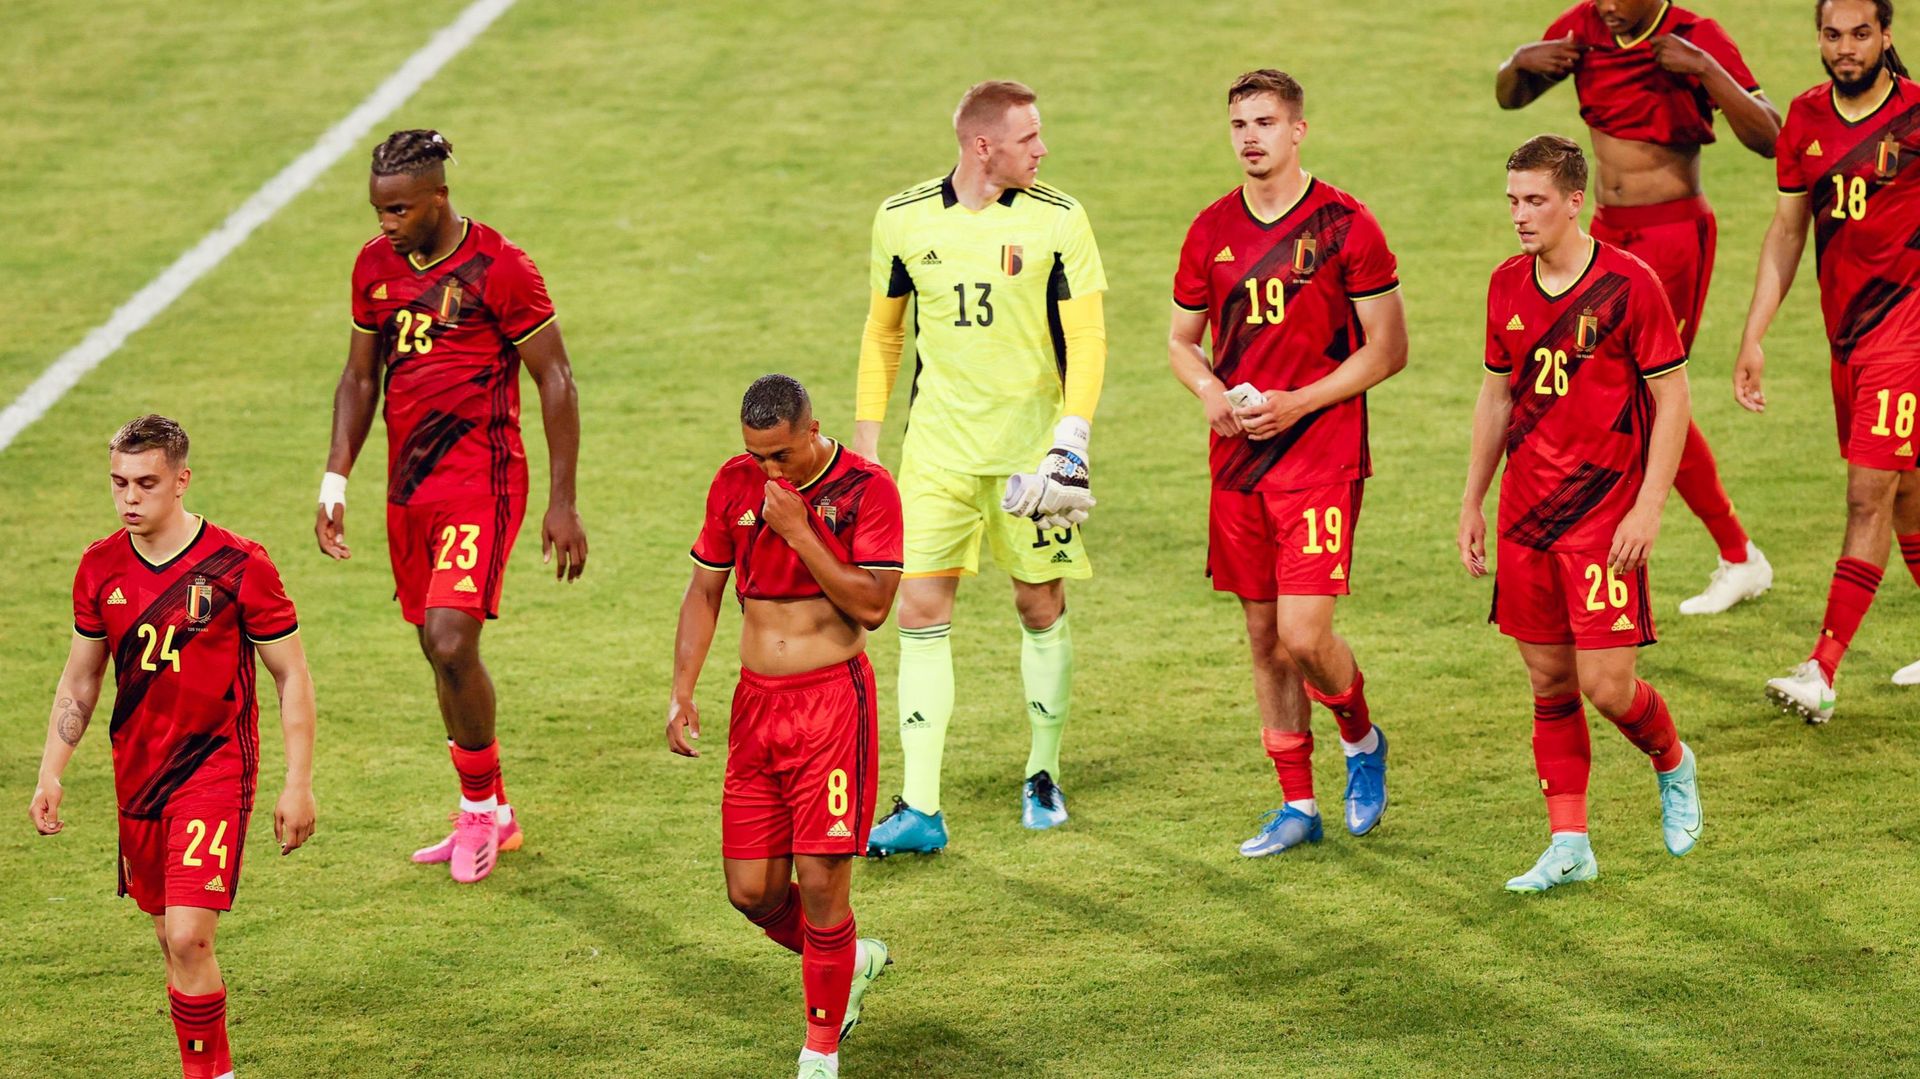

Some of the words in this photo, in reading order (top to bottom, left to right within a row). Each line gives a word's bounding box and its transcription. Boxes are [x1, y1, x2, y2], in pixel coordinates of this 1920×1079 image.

[1831, 173, 1867, 221] 18
[953, 283, 994, 327] 13
[1245, 277, 1285, 325] 19
[396, 309, 433, 355] 23
[1534, 347, 1569, 397] 26
[1871, 388, 1917, 439] 18
[437, 523, 481, 570] 23
[1302, 506, 1342, 554] 19
[1584, 563, 1628, 612] 26
[137, 623, 181, 673] 24
[827, 768, 848, 817] 8
[183, 818, 228, 870] 24
